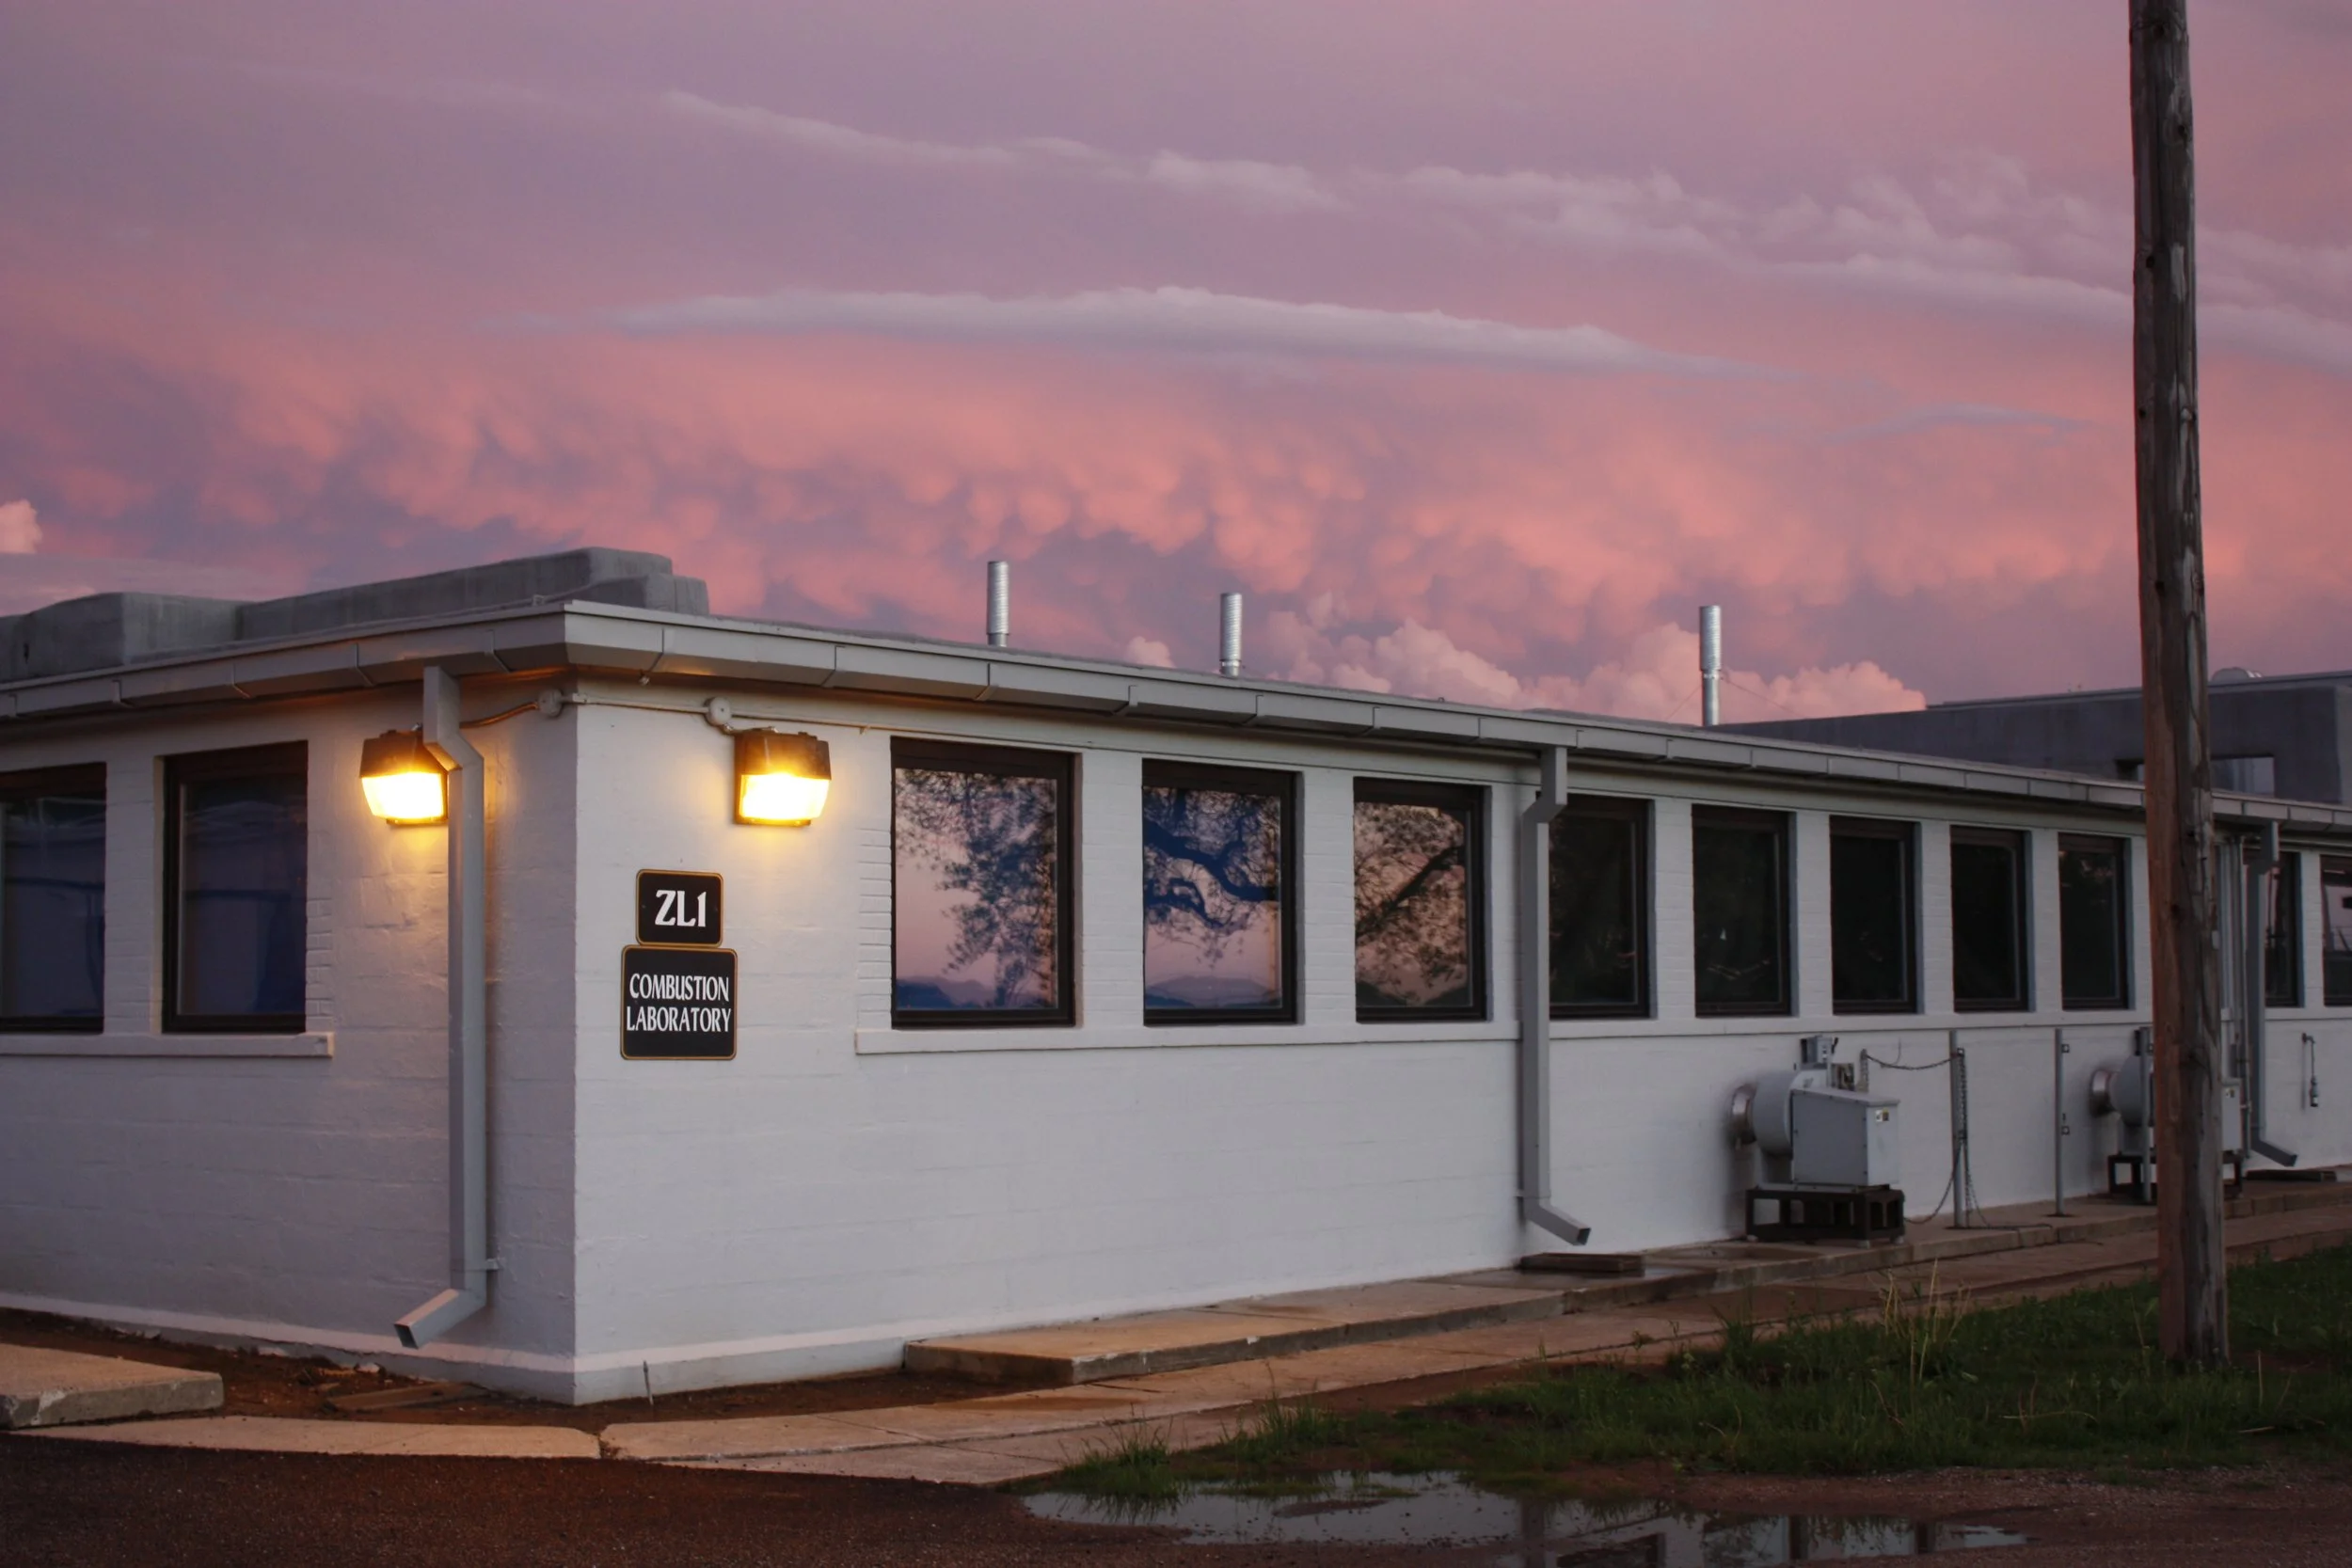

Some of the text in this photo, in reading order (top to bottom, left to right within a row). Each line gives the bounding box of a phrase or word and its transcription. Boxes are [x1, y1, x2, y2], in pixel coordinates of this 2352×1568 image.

[655, 890, 707, 927] ZL1
[629, 973, 729, 1002] COMBUSTION
[627, 1006, 731, 1032] LABORATORY
